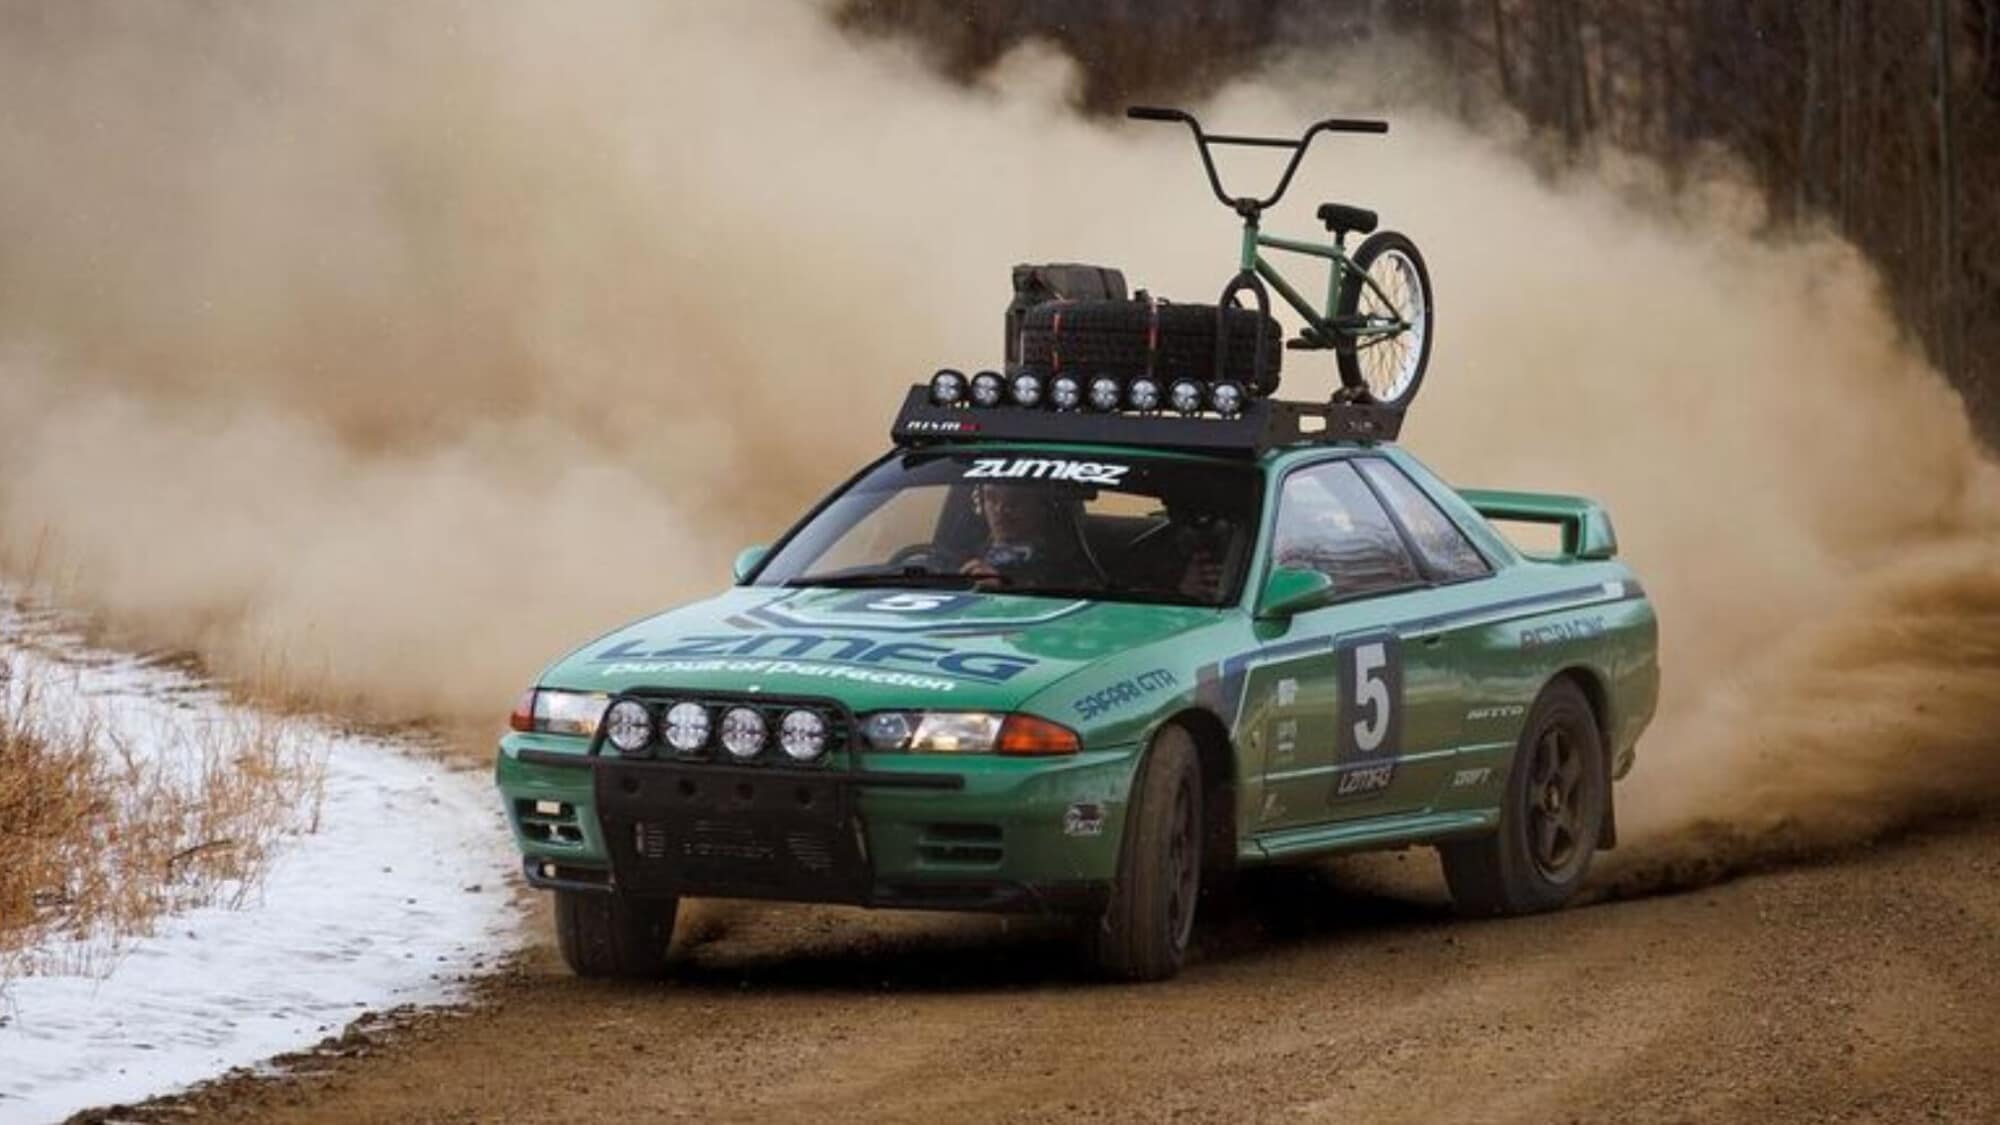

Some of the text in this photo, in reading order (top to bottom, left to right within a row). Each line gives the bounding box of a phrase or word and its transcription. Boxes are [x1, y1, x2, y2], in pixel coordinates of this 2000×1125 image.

[963, 459, 1129, 485] zumiez
[866, 592, 957, 611] 5
[600, 633, 1039, 684] LZMFG
[1073, 668, 1177, 721] SAFARI GTR
[1353, 642, 1390, 751] 5
